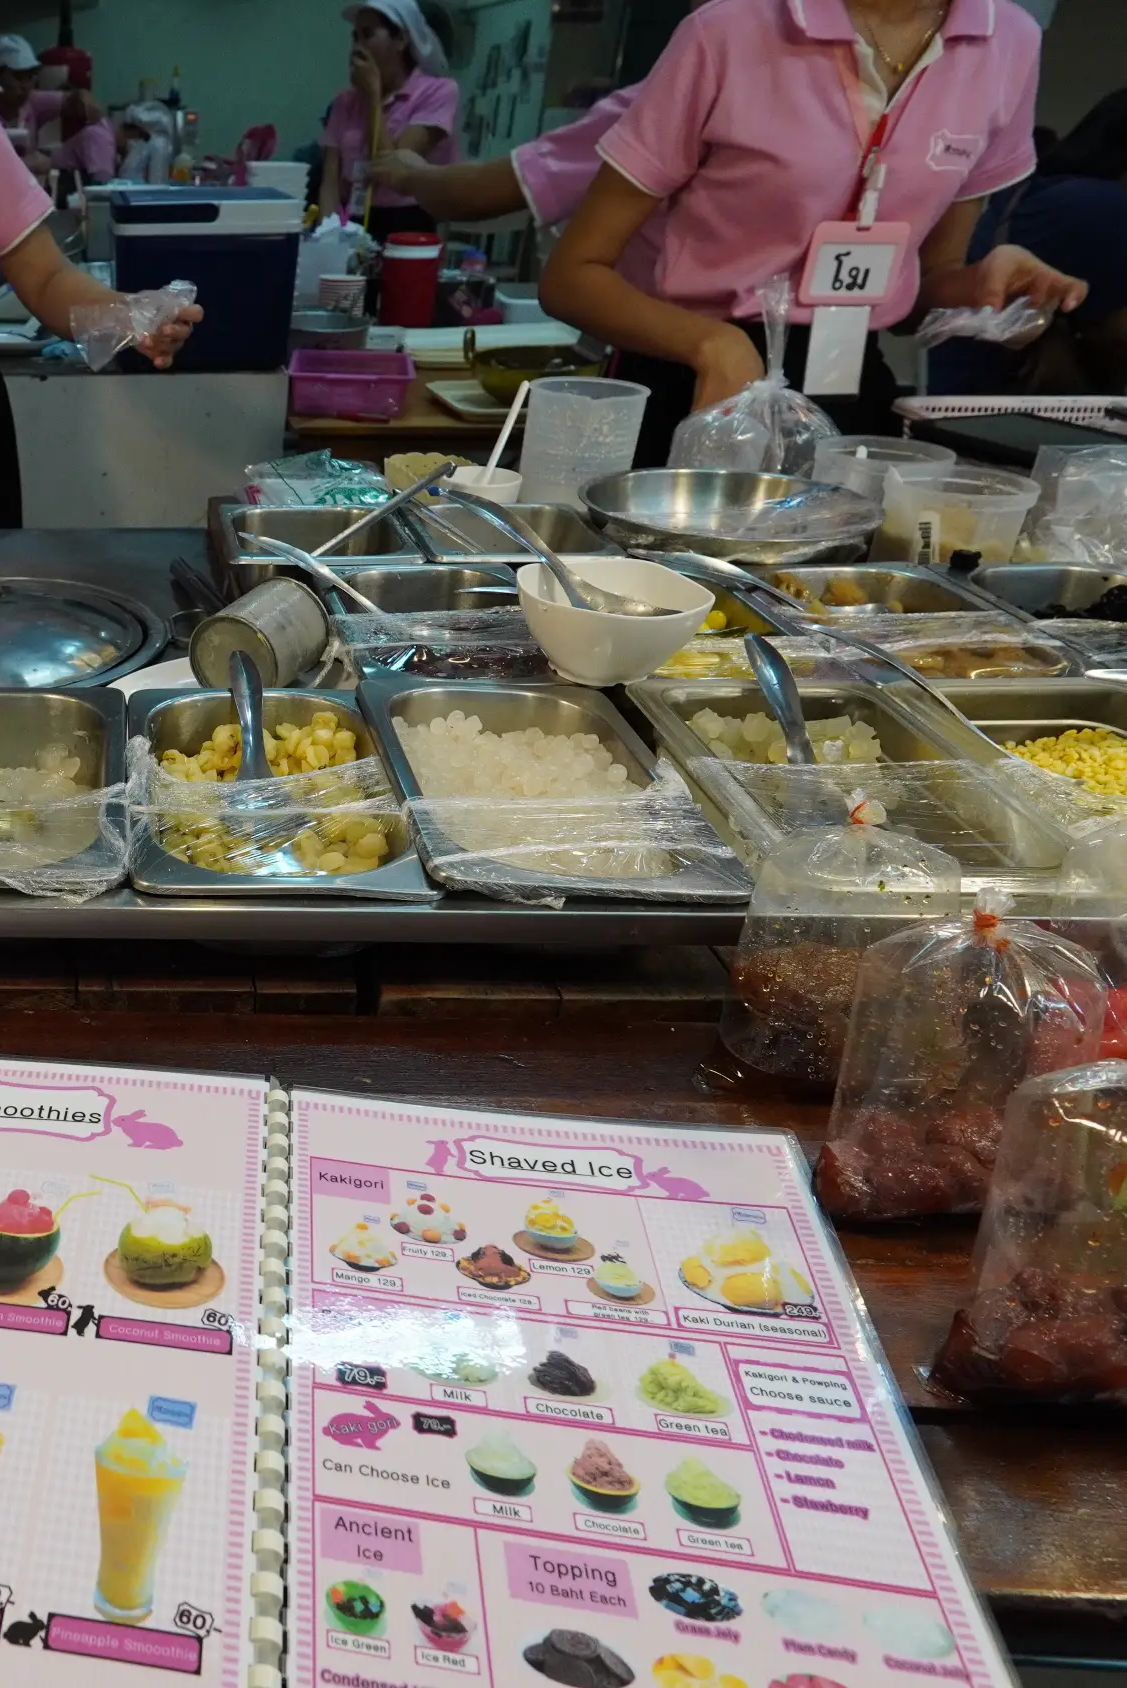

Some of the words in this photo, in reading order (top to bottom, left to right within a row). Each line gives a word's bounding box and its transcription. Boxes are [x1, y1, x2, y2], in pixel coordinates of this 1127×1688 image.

[832, 250, 870, 291] โม
[469, 1149, 577, 1175] Shaved
[589, 1161, 633, 1179] Ice
[319, 1171, 385, 1190] Kakigori
[531, 1262, 568, 1273] Lemon
[335, 1271, 370, 1284] Mango
[479, 1293, 516, 1304] Chocolate
[7, 1312, 64, 1328] Smoothie
[682, 1314, 710, 1325] Kaki
[714, 1317, 755, 1330] Durian
[758, 1322, 828, 1340] (seasonal)
[109, 1323, 160, 1339] Coconut
[163, 1330, 221, 1346] Smoothie
[744, 1370, 788, 1382] Kakigori
[791, 1376, 799, 1384] &
[443, 1388, 472, 1402] Milk
[750, 1386, 804, 1402] Choose
[809, 1395, 852, 1408] sauce
[535, 1402, 605, 1421] Chocolate
[329, 1422, 362, 1436] Kaki
[367, 1416, 399, 1434] gori
[658, 1418, 702, 1434] Green
[705, 1424, 729, 1437] tea
[775, 1449, 845, 1470] Chocolate
[322, 1458, 353, 1474] Can
[358, 1464, 420, 1486] Choose
[426, 1475, 451, 1490] Ice
[492, 1504, 522, 1519] Milk
[334, 1516, 414, 1543] Ancient
[584, 1518, 641, 1537] Chocolate
[687, 1534, 722, 1549] Green
[724, 1539, 744, 1551] tea
[357, 1544, 384, 1562] Ice
[529, 1555, 618, 1589] Topping
[528, 1580, 545, 1594] 10
[551, 1585, 585, 1601] Baht
[590, 1591, 627, 1608] Each
[51, 1627, 120, 1649] Pineapple
[330, 1635, 349, 1647] Ice
[352, 1639, 387, 1654] Green
[421, 1651, 439, 1663] Ice
[442, 1655, 467, 1668] Red
